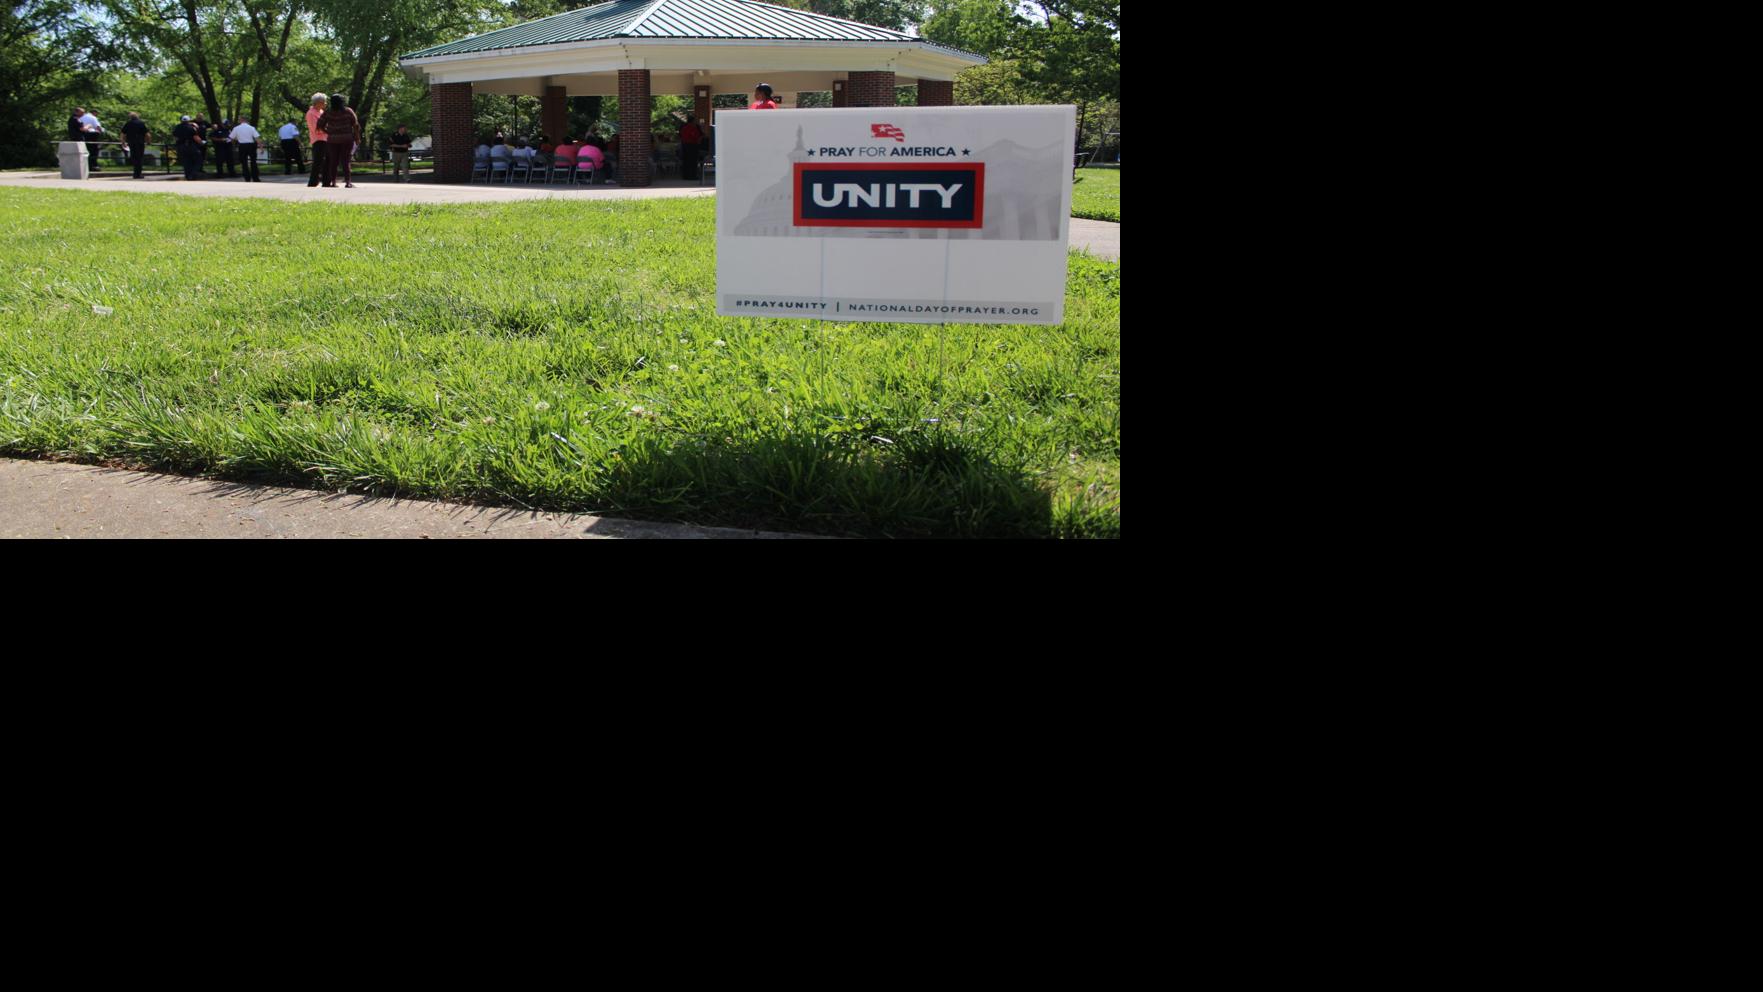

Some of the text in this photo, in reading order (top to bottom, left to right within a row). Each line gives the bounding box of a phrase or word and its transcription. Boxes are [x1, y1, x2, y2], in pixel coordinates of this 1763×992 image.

[819, 147, 956, 157] PRAY FOR AMERICA
[813, 183, 963, 208] UNITY
[735, 300, 1039, 316] #PRAY4UNITY NATIONALDAYOFPRAYER.ORG
